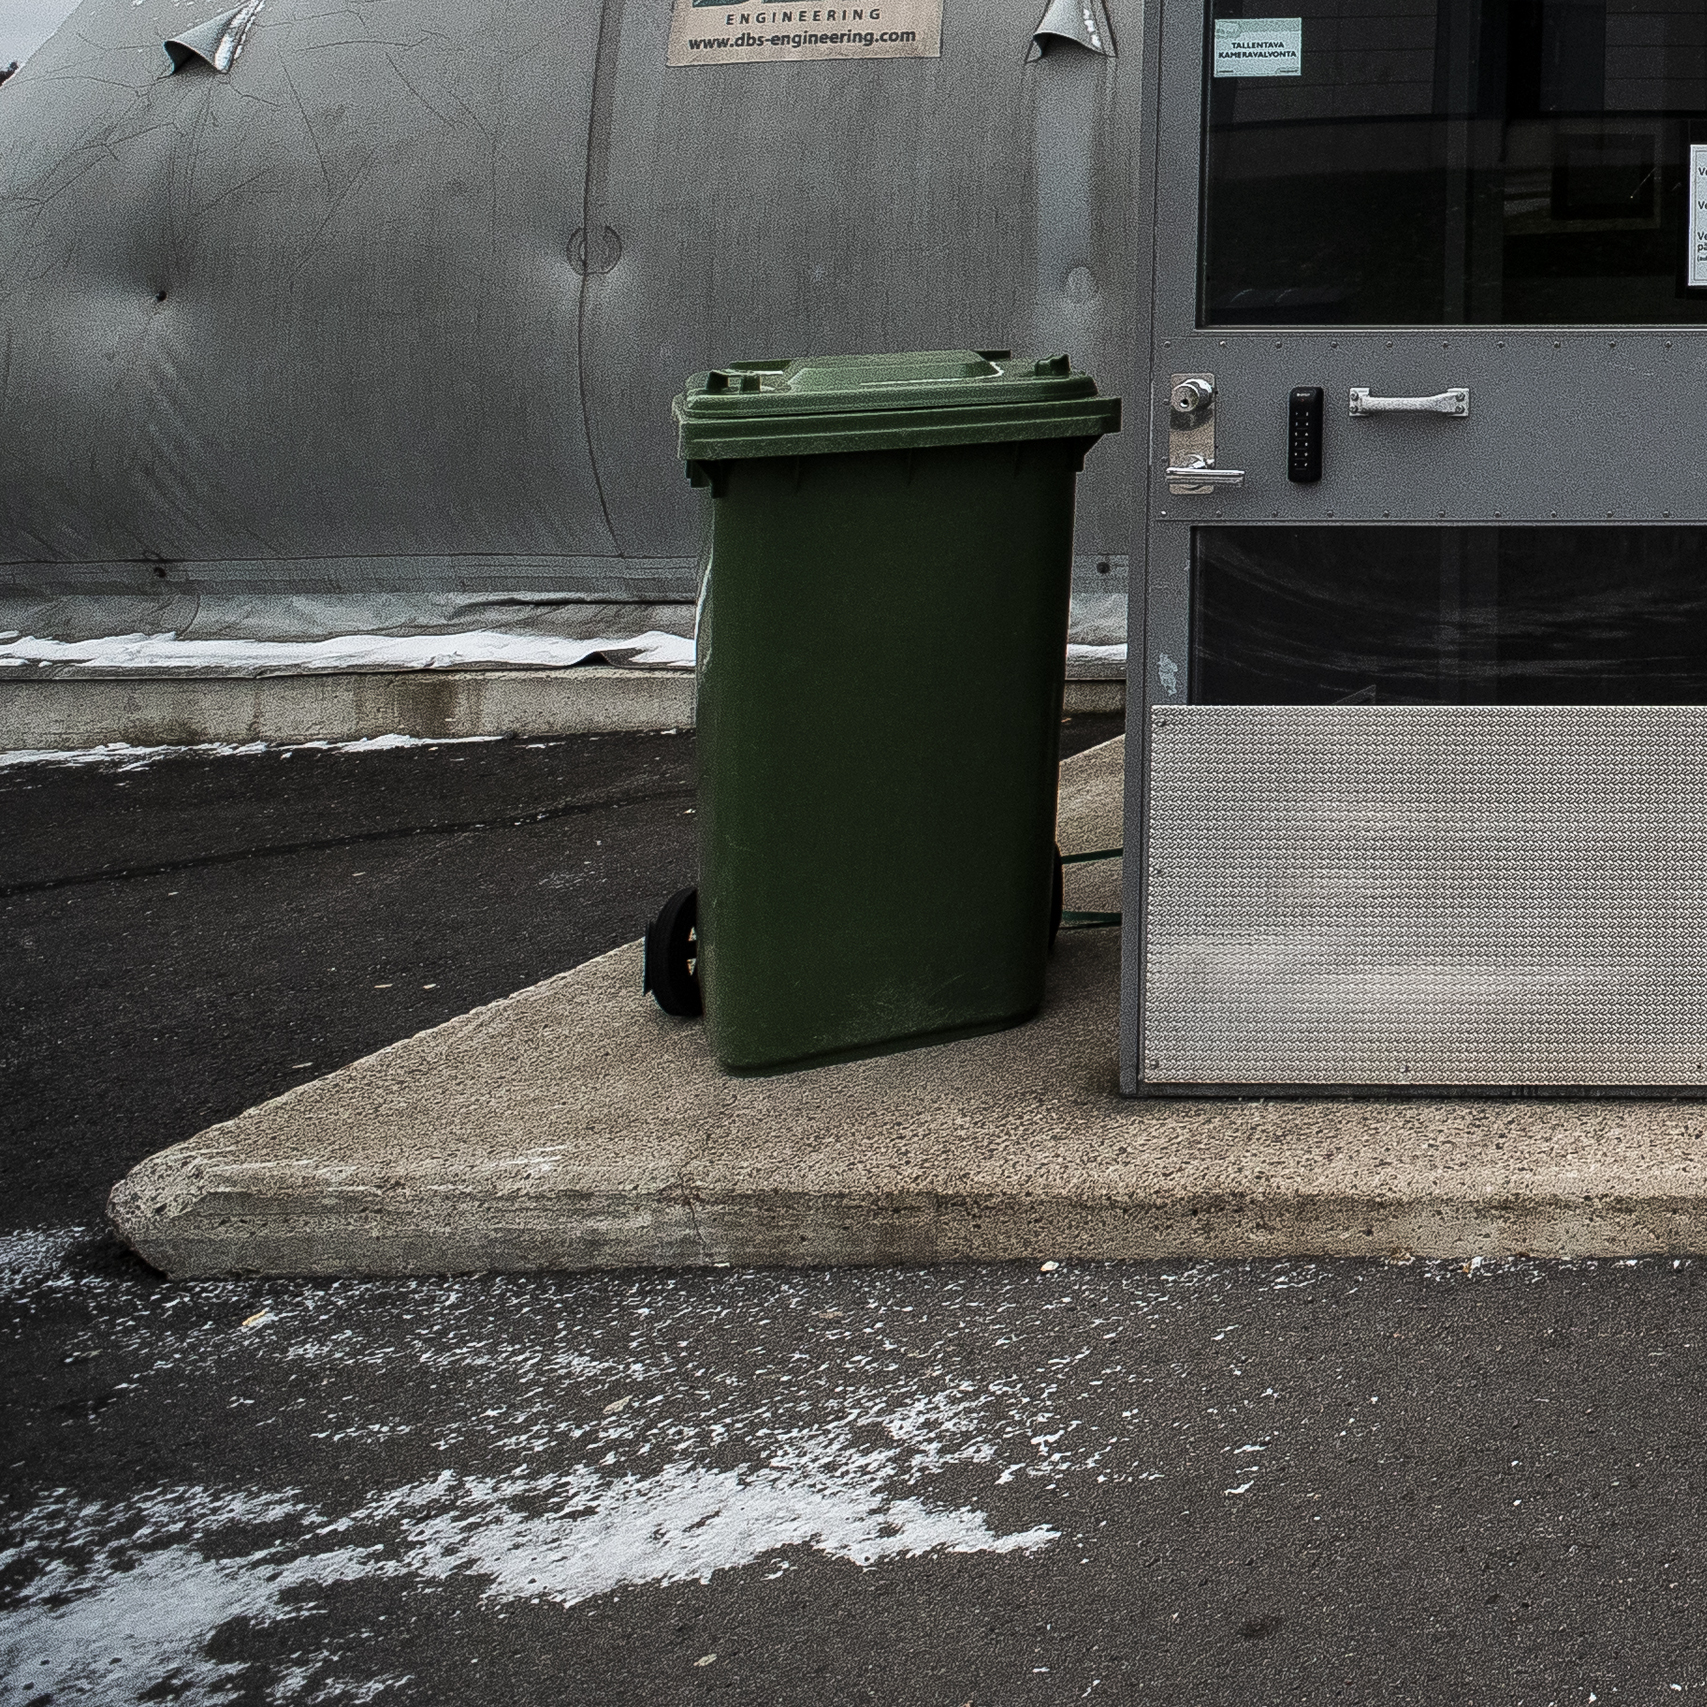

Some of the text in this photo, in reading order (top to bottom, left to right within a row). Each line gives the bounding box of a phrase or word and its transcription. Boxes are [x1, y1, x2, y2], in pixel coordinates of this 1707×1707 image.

[726, 9, 881, 26] ENGINEERING
[688, 29, 916, 50] www.dbs-engineering.com
[1231, 41, 1285, 49] TALLENTAVA
[1218, 51, 1297, 59] KAMERAVALVONTA
